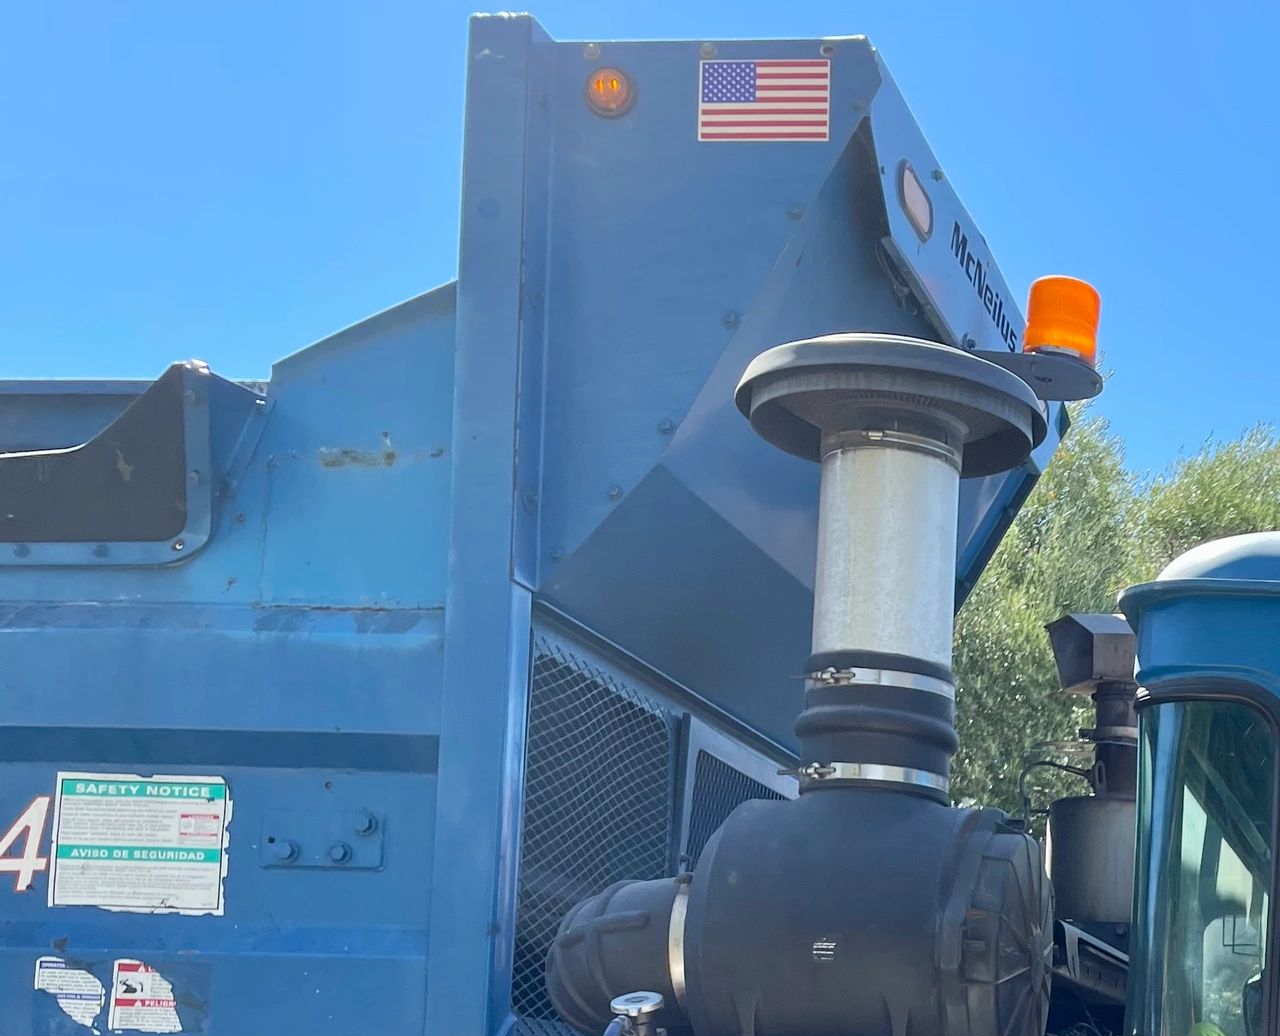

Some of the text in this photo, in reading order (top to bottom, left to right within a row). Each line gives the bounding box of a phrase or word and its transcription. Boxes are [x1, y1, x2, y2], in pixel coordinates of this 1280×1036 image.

[951, 221, 1017, 352] McNeilus
[76, 783, 210, 797] SAFETY NOTICE
[71, 849, 205, 860] AVISO DE SEGURIDAD
